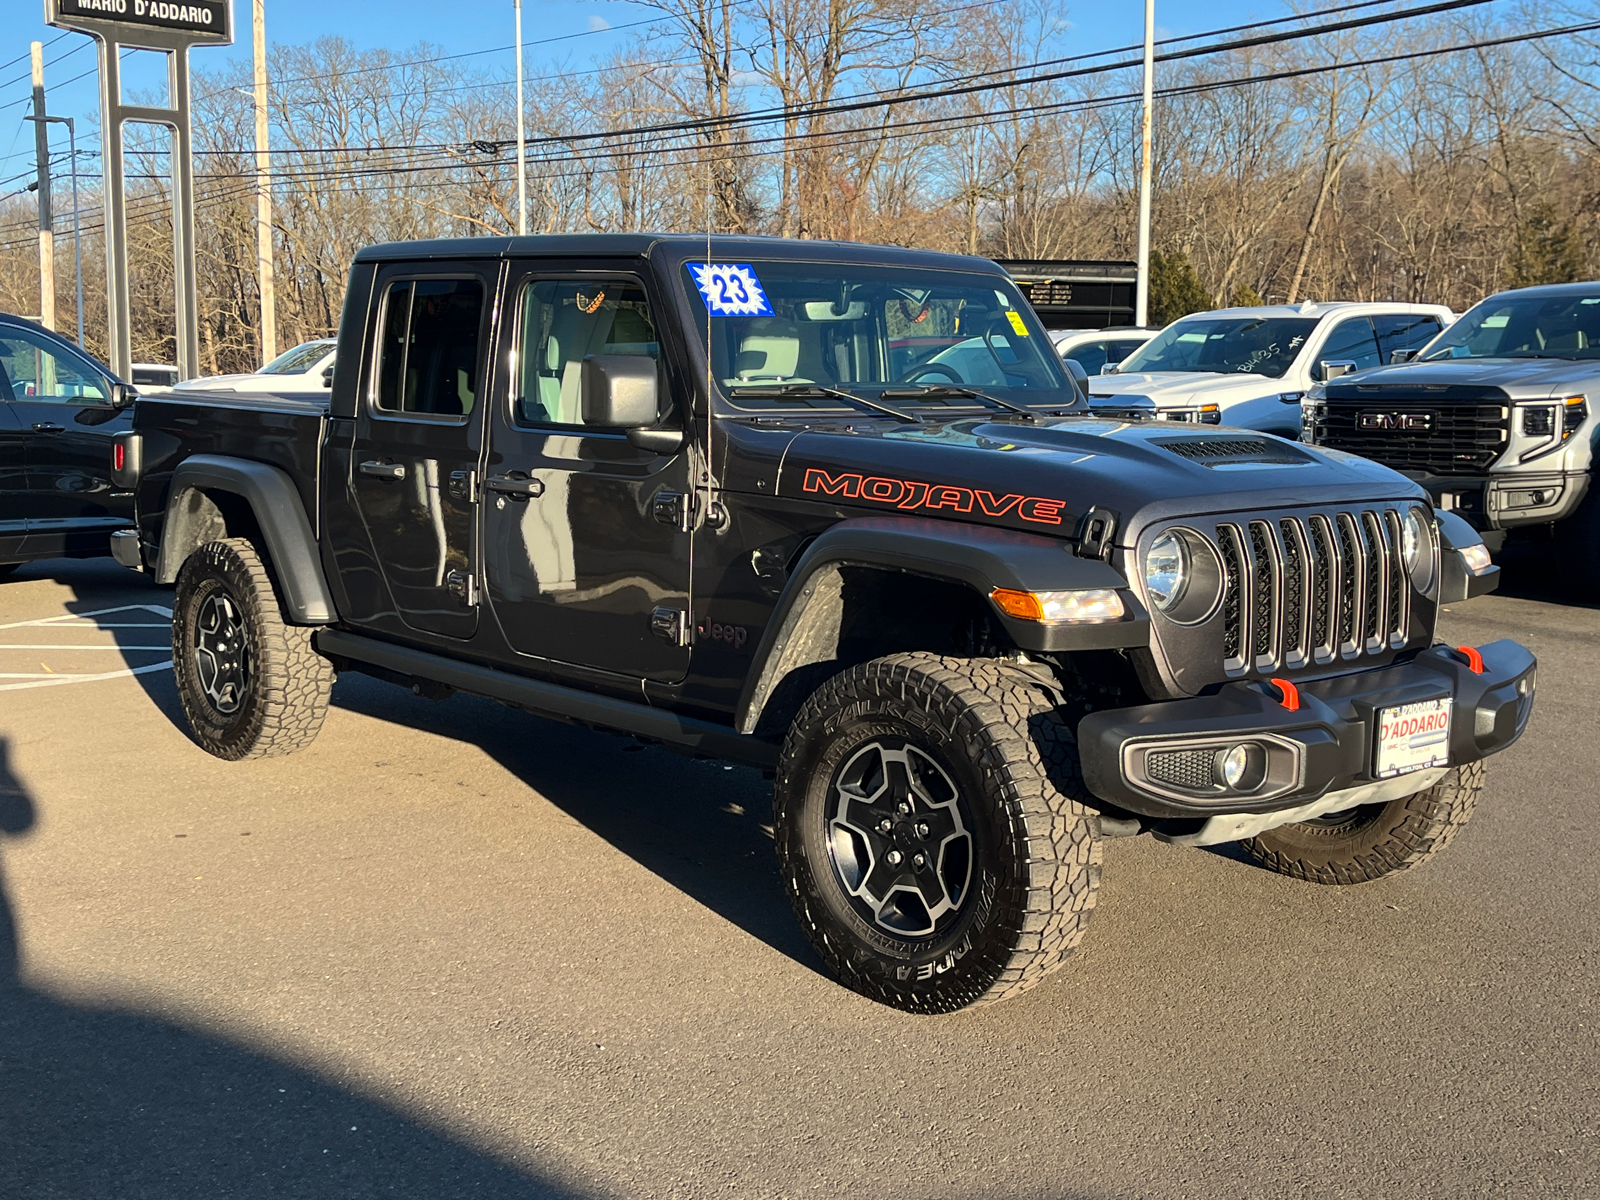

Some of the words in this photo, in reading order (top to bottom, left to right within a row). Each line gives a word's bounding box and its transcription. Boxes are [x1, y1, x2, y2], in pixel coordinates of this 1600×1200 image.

[134, 0, 212, 24] D'ADDARIO
[712, 273, 749, 304] 23
[1360, 413, 1431, 430] GMC
[802, 468, 1067, 525] MOJAVE
[698, 616, 748, 649] Jeep
[1381, 711, 1447, 741] D'ADDARIO
